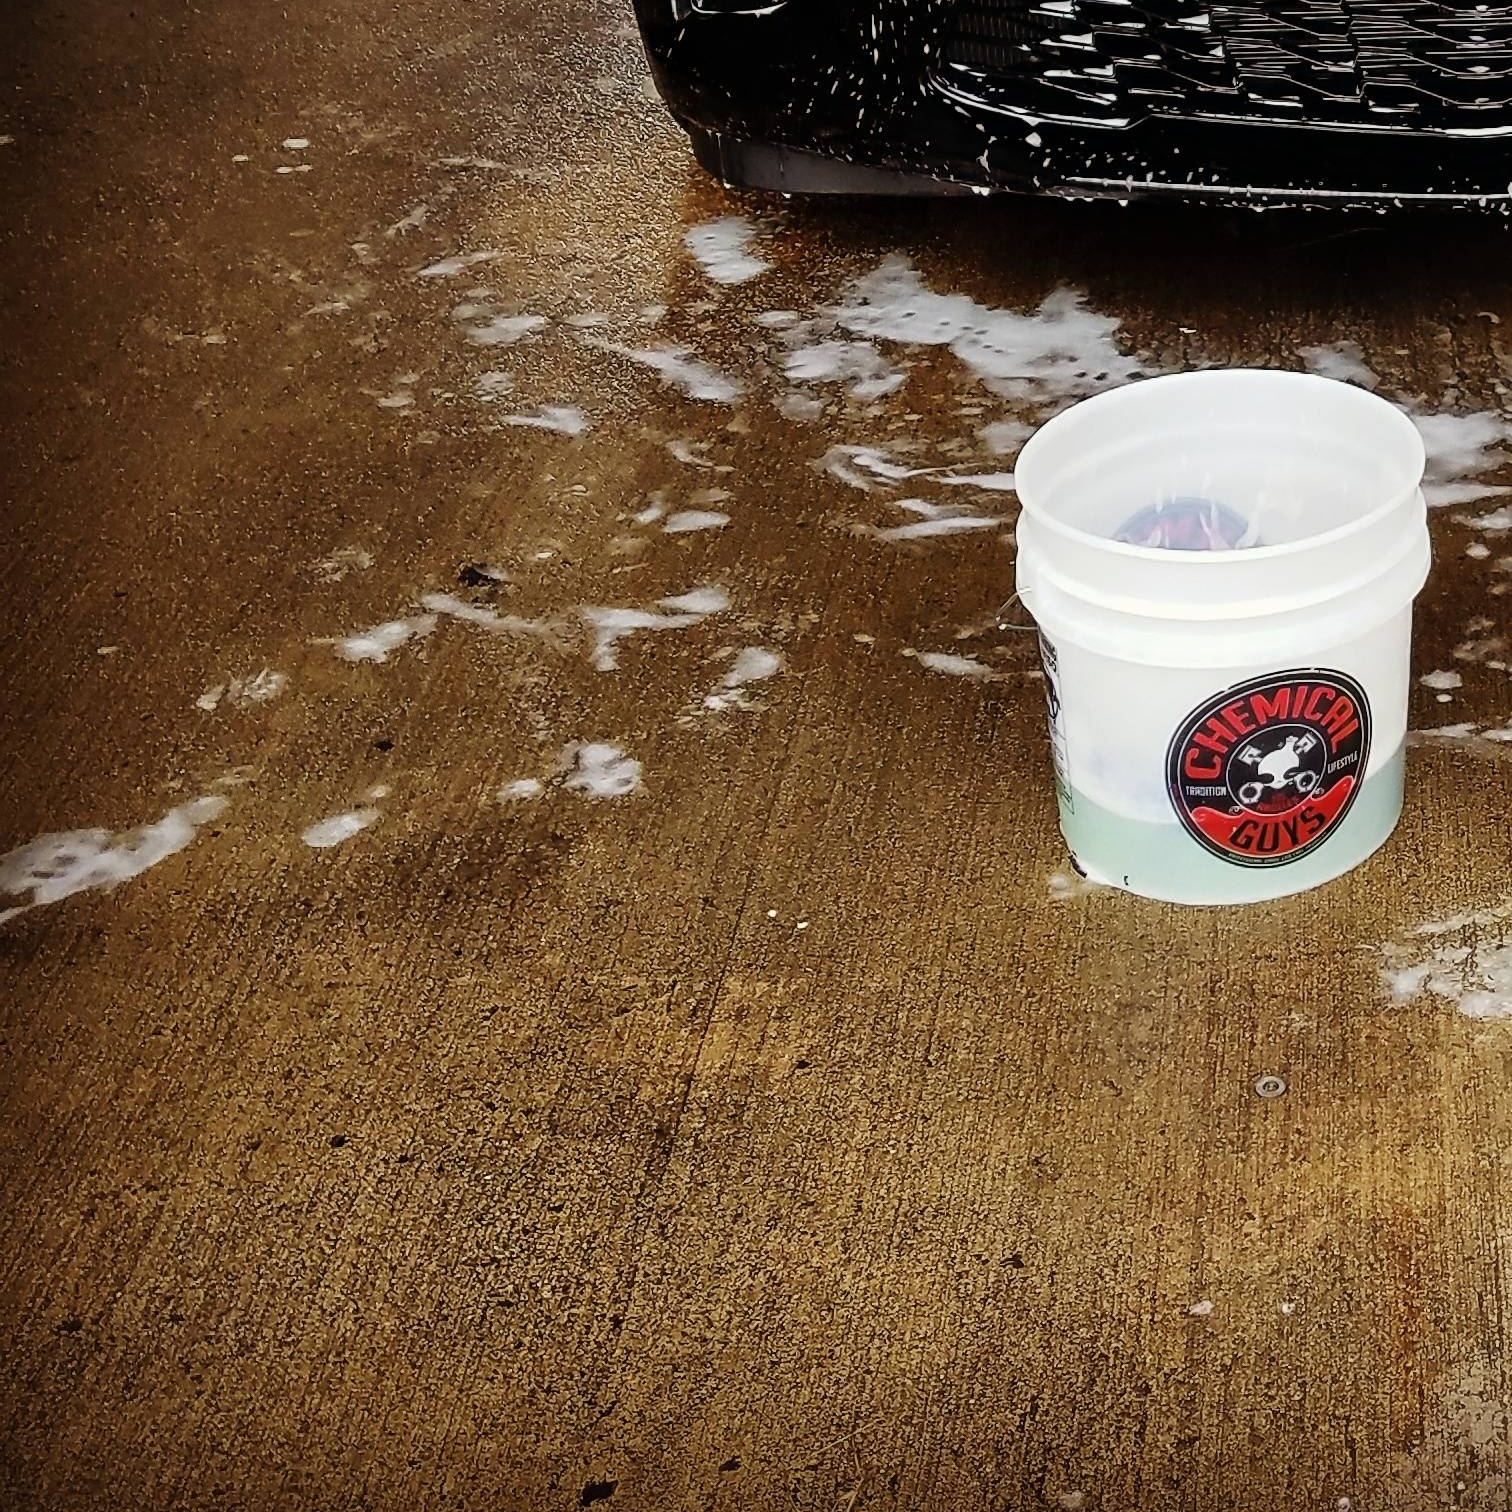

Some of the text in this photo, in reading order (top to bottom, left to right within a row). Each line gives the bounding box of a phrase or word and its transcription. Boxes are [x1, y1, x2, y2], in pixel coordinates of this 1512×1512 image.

[1184, 684, 1361, 781] CHEMICAL
[1327, 750, 1358, 774] LIFESTYLE
[1228, 805, 1327, 852] GUYS
